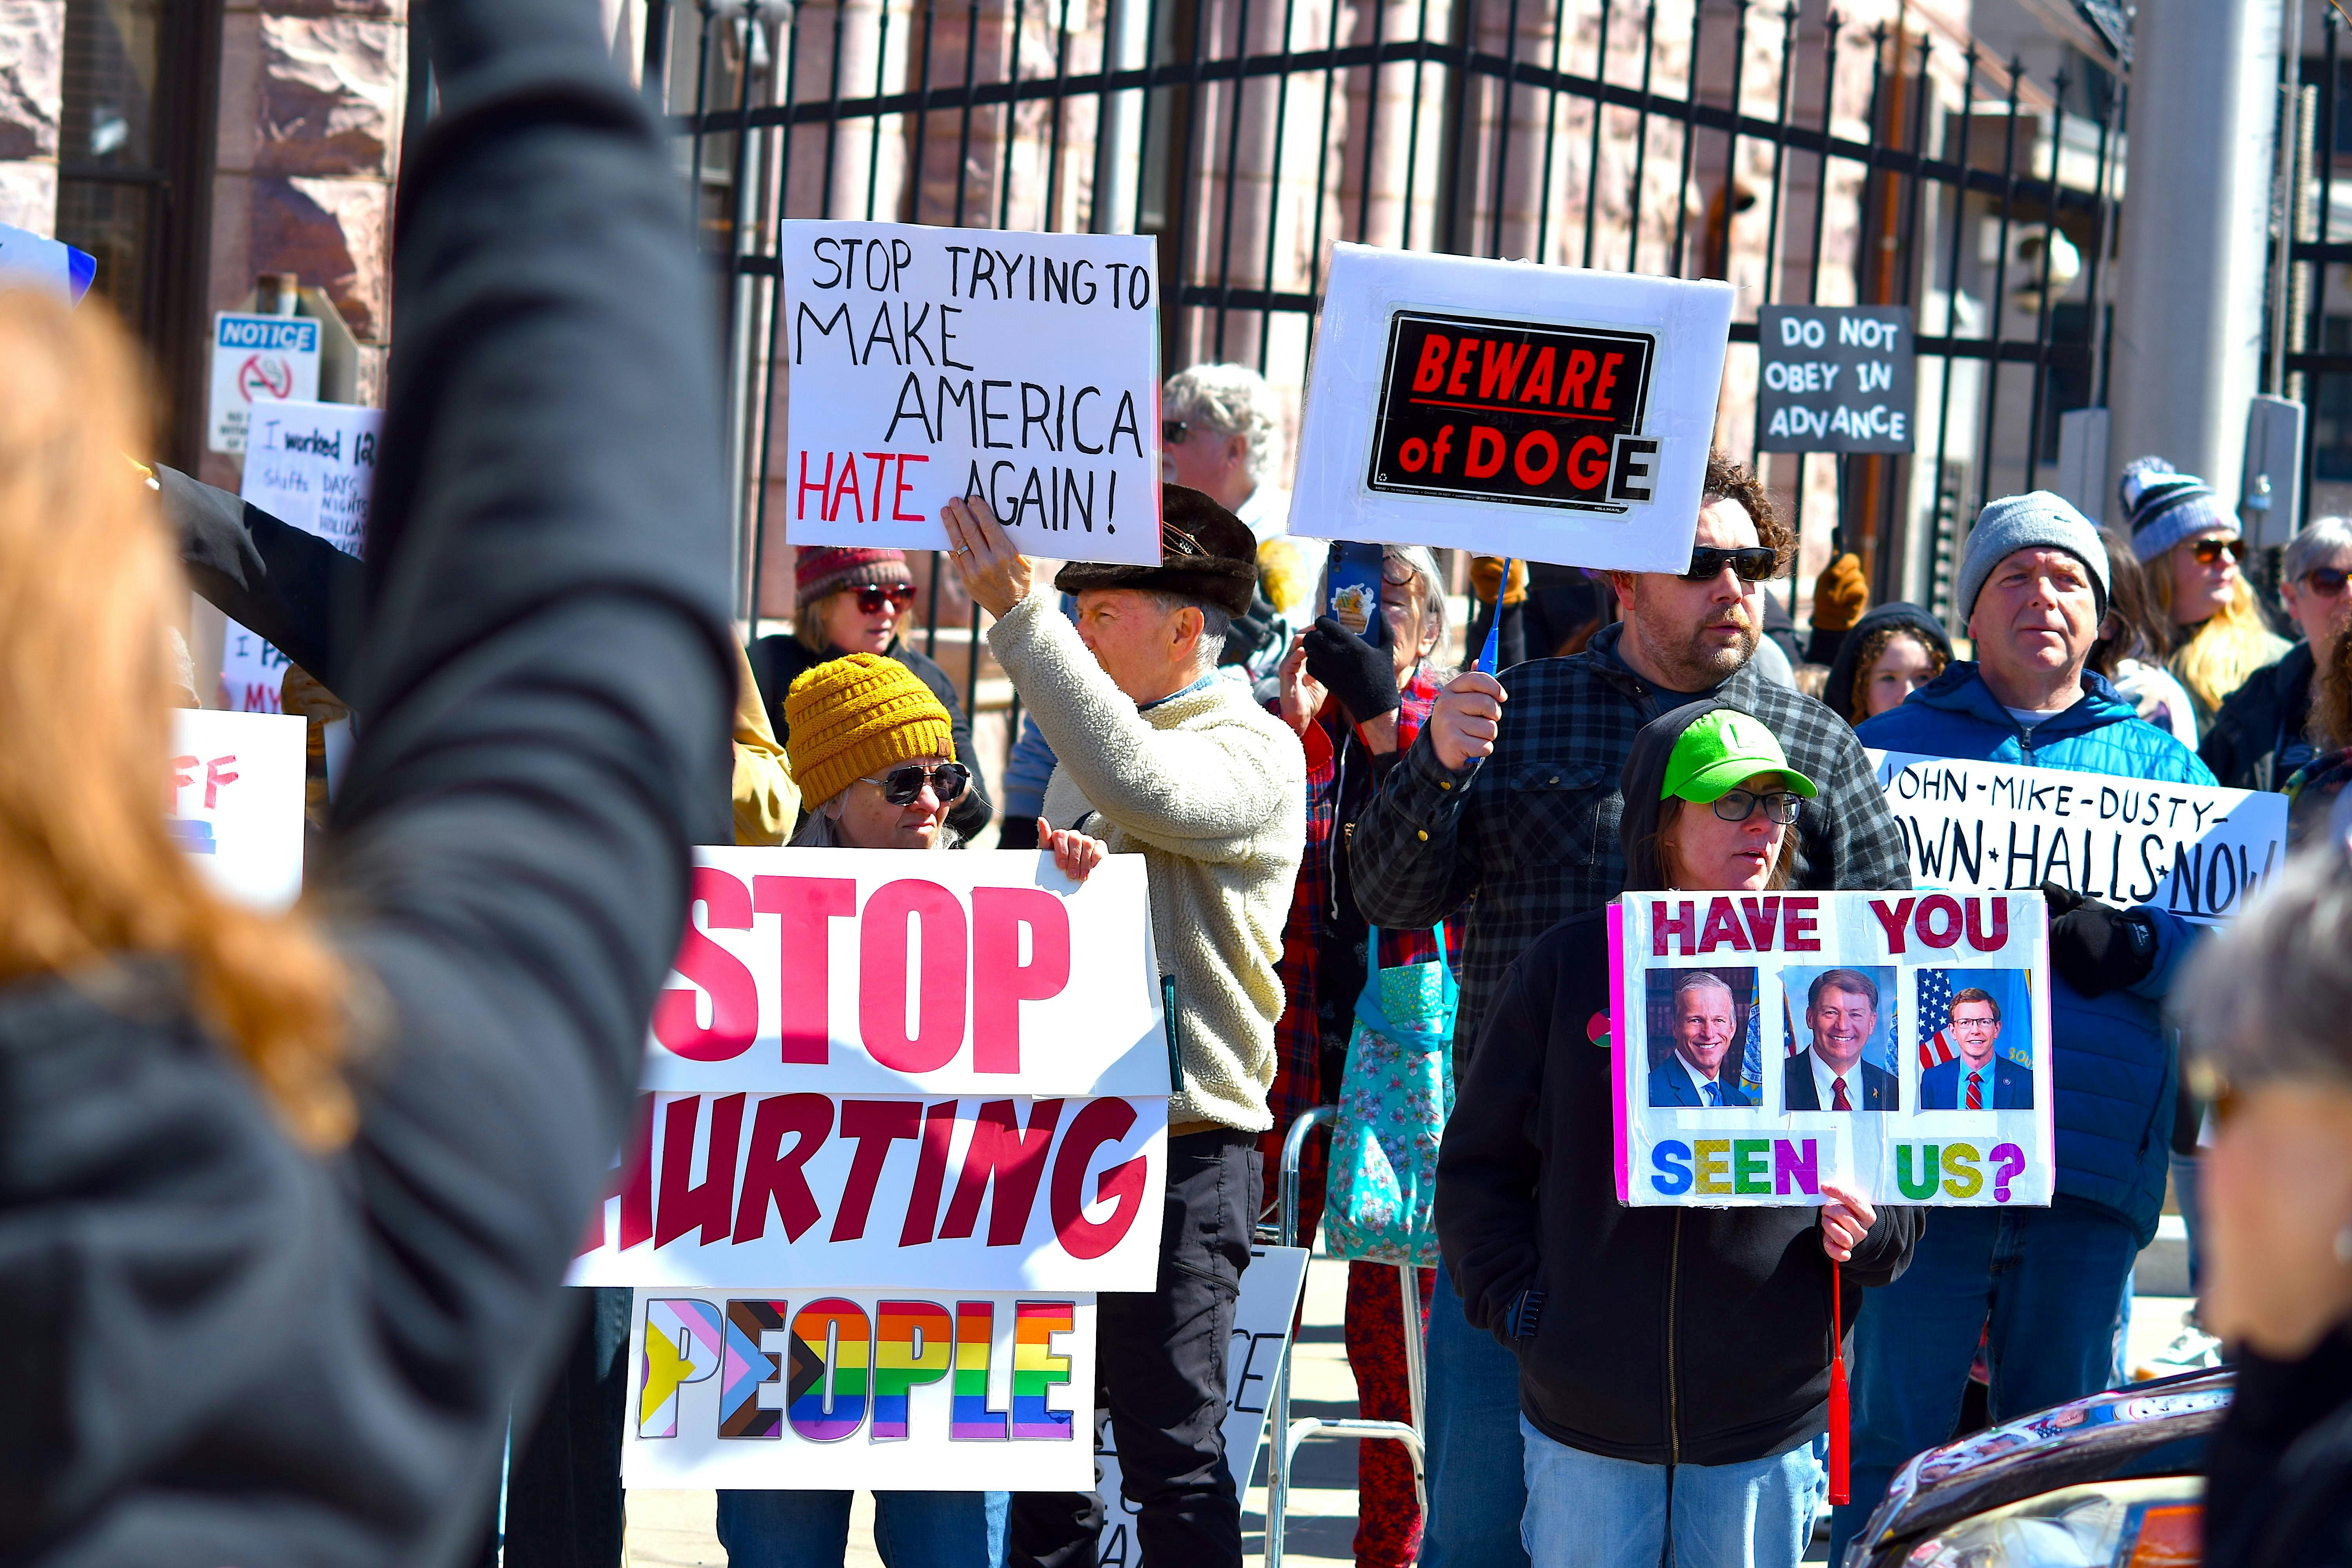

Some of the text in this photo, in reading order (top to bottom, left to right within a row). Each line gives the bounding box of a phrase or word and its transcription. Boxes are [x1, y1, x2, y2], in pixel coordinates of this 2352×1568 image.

[813, 237, 1150, 310] STOP TRYING TO
[223, 322, 313, 348] NOTICE
[797, 301, 974, 372] MAKE
[1780, 316, 1898, 352] DO NOT
[1412, 334, 1624, 411] BEWARE
[1765, 360, 1893, 393] OBEY IN
[262, 420, 281, 449] I
[285, 427, 341, 461] worked
[884, 371, 1143, 459] AMERICA
[1768, 404, 1906, 442] ADVANCE
[797, 450, 1116, 535] HATE AGAIN!
[1399, 424, 1658, 501] of DOGE
[236, 635, 250, 657] I
[244, 682, 282, 713] MY
[2005, 821, 2164, 903] HALLS
[2169, 840, 2277, 915] NOW
[1651, 894, 2009, 956] HAVE YOU
[651, 866, 1070, 1074] STOP
[1651, 1139, 2026, 1203] SEEN US?
[637, 1296, 1076, 1443] PEOPLE
